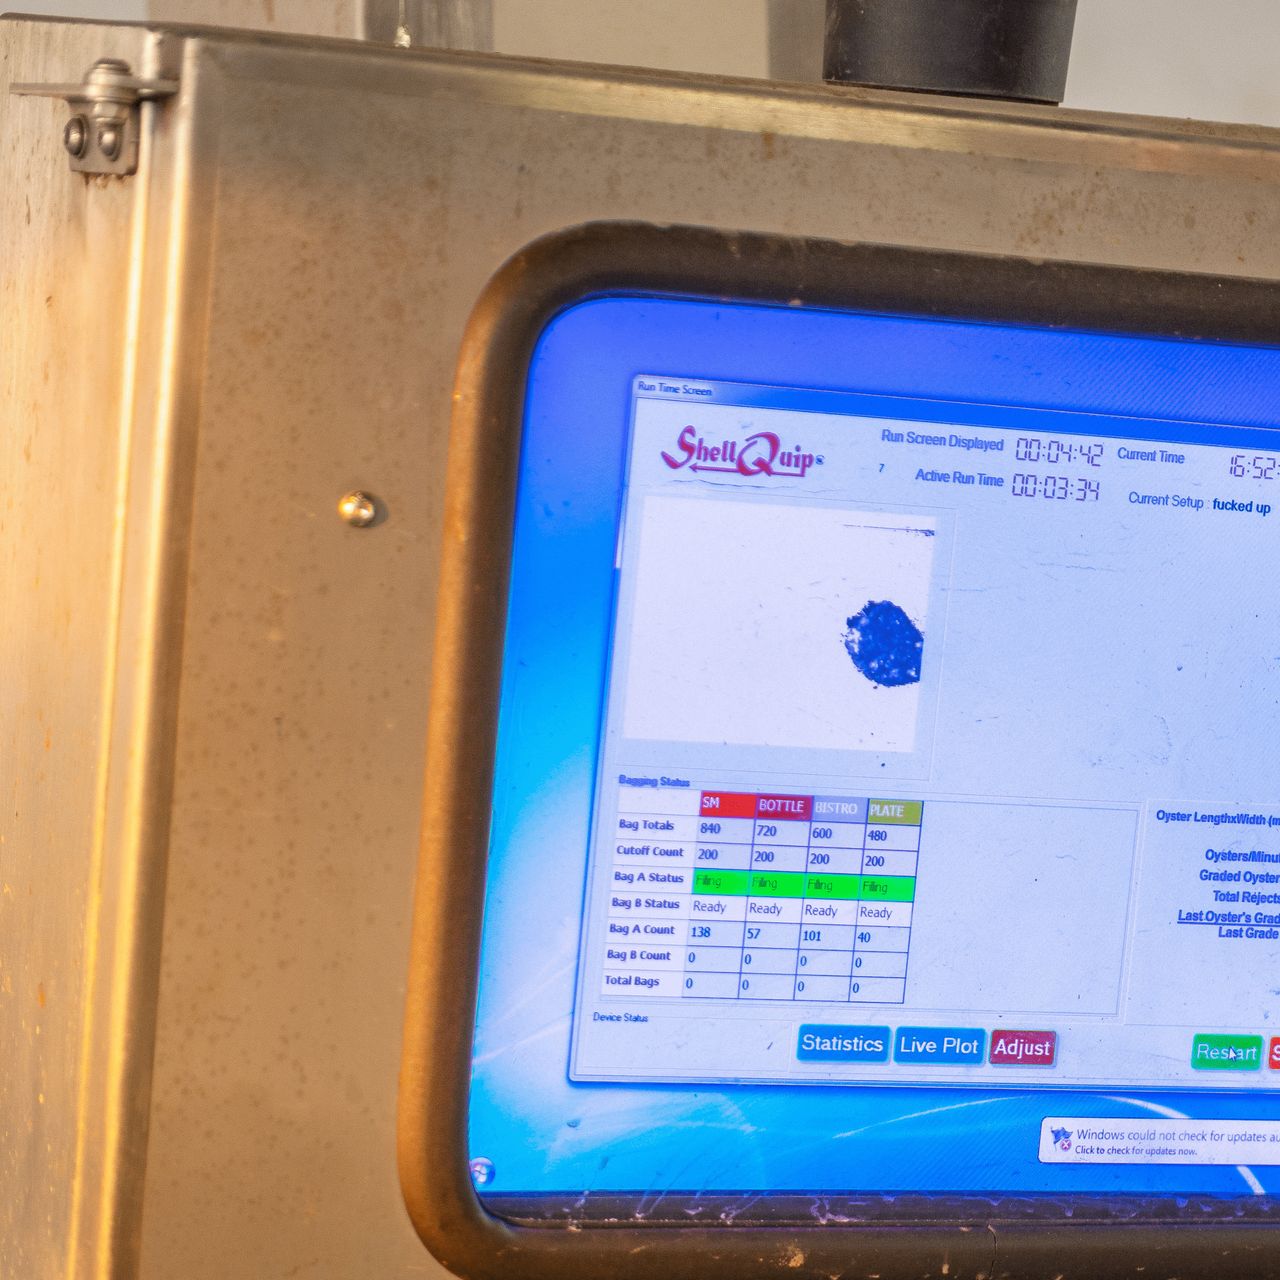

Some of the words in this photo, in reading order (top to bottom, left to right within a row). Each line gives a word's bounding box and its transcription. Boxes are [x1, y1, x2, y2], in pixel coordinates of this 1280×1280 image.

[638, 381, 656, 391] Run
[658, 383, 680, 393] Time
[682, 385, 712, 396] Screen
[881, 429, 904, 442] Run
[906, 432, 946, 446] Screen
[949, 435, 1004, 452] Displayed
[1016, 438, 1103, 467] 00:04:42
[1117, 447, 1157, 462] Current
[1159, 450, 1185, 464] Time
[915, 469, 950, 483] Active
[953, 472, 975, 485] Run
[977, 473, 1004, 487] Time
[1012, 473, 1100, 501] 00:03:34
[1129, 491, 1170, 505] Current
[1172, 495, 1204, 511] Setup
[1213, 498, 1253, 512] fucked
[1256, 502, 1271, 516] up
[619, 775, 658, 787] Bagging
[660, 776, 690, 787] Status
[703, 796, 720, 808] SM
[759, 800, 804, 812] BOTTLE
[815, 802, 858, 814] BISTRO
[870, 804, 904, 817] PLATE
[1156, 809, 1192, 823] Oyster
[1194, 812, 1266, 825] LengthxWidth
[619, 819, 639, 831] Bag
[643, 820, 674, 830] Totals
[700, 823, 721, 834] 840
[757, 825, 777, 836] 720
[812, 828, 832, 839] 600
[868, 830, 887, 841] 480
[617, 845, 650, 856] Cutoff
[653, 847, 684, 857] Count
[698, 849, 718, 860] 200
[754, 851, 774, 862] 200
[810, 854, 830, 865] 200
[865, 856, 884, 867] 200
[615, 872, 634, 883] Bag
[637, 872, 645, 881] A
[649, 873, 684, 883] Status
[1199, 869, 1241, 882] Graded
[1213, 891, 1240, 902] Total
[612, 898, 631, 909] Bag
[635, 899, 641, 907] B
[645, 899, 680, 909] Status
[693, 901, 726, 914] Ready
[750, 903, 782, 916] Ready
[805, 905, 837, 918] Ready
[860, 907, 892, 920] Ready
[1178, 910, 1203, 922] Last
[1205, 911, 1252, 925] Oyster's
[609, 924, 629, 935] Bag
[632, 925, 641, 933] A
[644, 925, 675, 935] Count
[691, 927, 711, 937] 138
[747, 928, 761, 939] 57
[803, 931, 821, 941] 101
[858, 932, 871, 943] 40
[1218, 927, 1244, 938] Last
[1245, 928, 1279, 939] Grade
[607, 950, 627, 961] Bag
[630, 950, 636, 959] B
[640, 950, 671, 960] Count
[688, 952, 695, 963] 0
[745, 954, 751, 965] 0
[800, 956, 807, 966] 0
[855, 958, 862, 968] 0
[606, 976, 632, 985] Total
[634, 977, 659, 988] Bags
[686, 978, 693, 988] 0
[742, 980, 749, 990] 0
[798, 981, 804, 992] 0
[853, 983, 859, 993] 0
[593, 1012, 621, 1022] Device
[624, 1013, 648, 1022] Status
[801, 1034, 884, 1051] Statistics
[900, 1036, 937, 1053] Live
[943, 1037, 979, 1054] Plot
[994, 1039, 1050, 1059] Adjust
[1076, 1129, 1125, 1141] Windows
[1127, 1130, 1156, 1141] could
[1158, 1131, 1176, 1141] not
[1178, 1130, 1207, 1141] check
[1209, 1131, 1225, 1142] for
[1227, 1132, 1267, 1144] updates
[1075, 1145, 1095, 1154] Click
[1096, 1146, 1105, 1155] to
[1107, 1145, 1130, 1155] check
[1132, 1146, 1144, 1155] for
[1145, 1146, 1176, 1158] updates
[1178, 1148, 1198, 1156] now.
